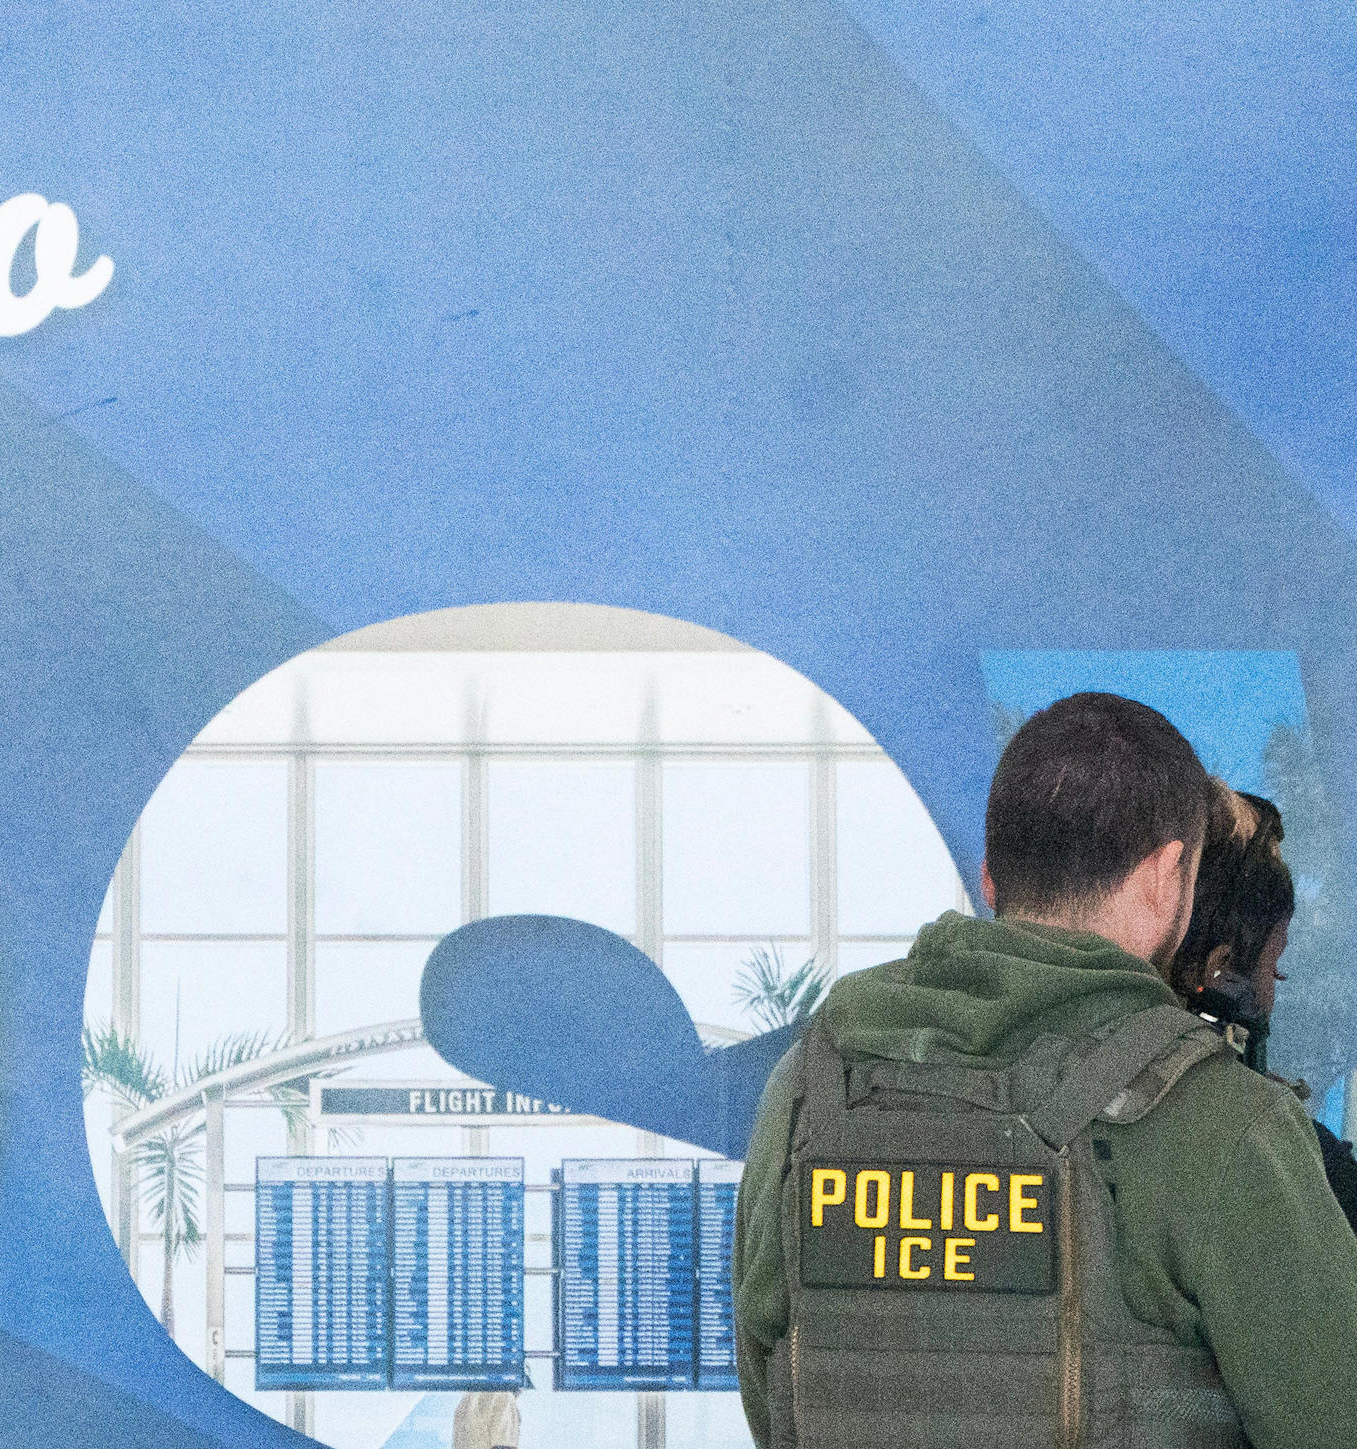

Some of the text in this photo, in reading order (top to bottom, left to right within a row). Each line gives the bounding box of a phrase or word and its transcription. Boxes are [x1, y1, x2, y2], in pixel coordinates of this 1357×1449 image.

[408, 1091, 496, 1113] FLIGHT
[297, 1166, 386, 1179] DEPARTURES
[432, 1166, 521, 1179] DEPARTURES
[626, 1168, 692, 1180] ARRIVALS
[811, 1168, 1044, 1233] POLICE
[873, 1235, 976, 1281] ICE
